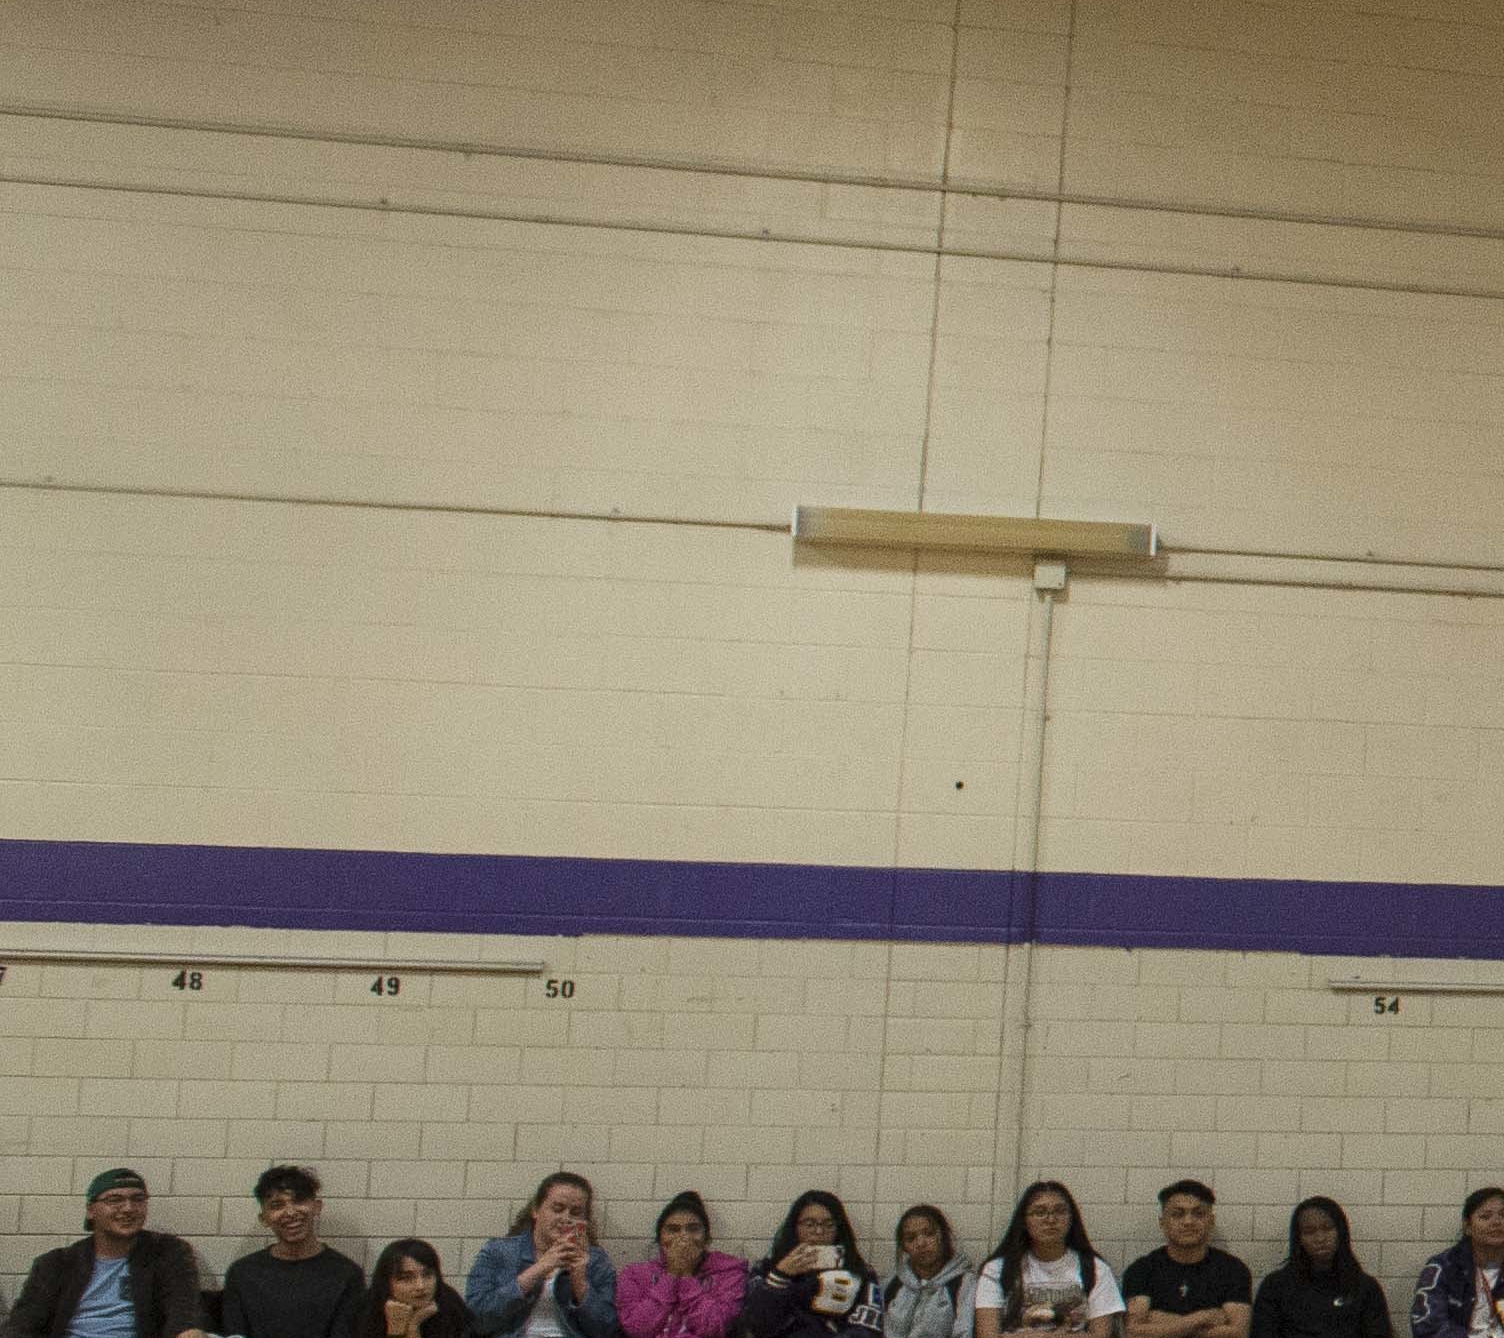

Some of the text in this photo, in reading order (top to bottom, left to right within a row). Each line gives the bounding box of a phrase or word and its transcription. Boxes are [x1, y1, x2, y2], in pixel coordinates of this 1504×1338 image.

[172, 971, 203, 991] 48
[370, 976, 401, 996] 49
[545, 979, 575, 999] 50
[1373, 996, 1400, 1015] 54
